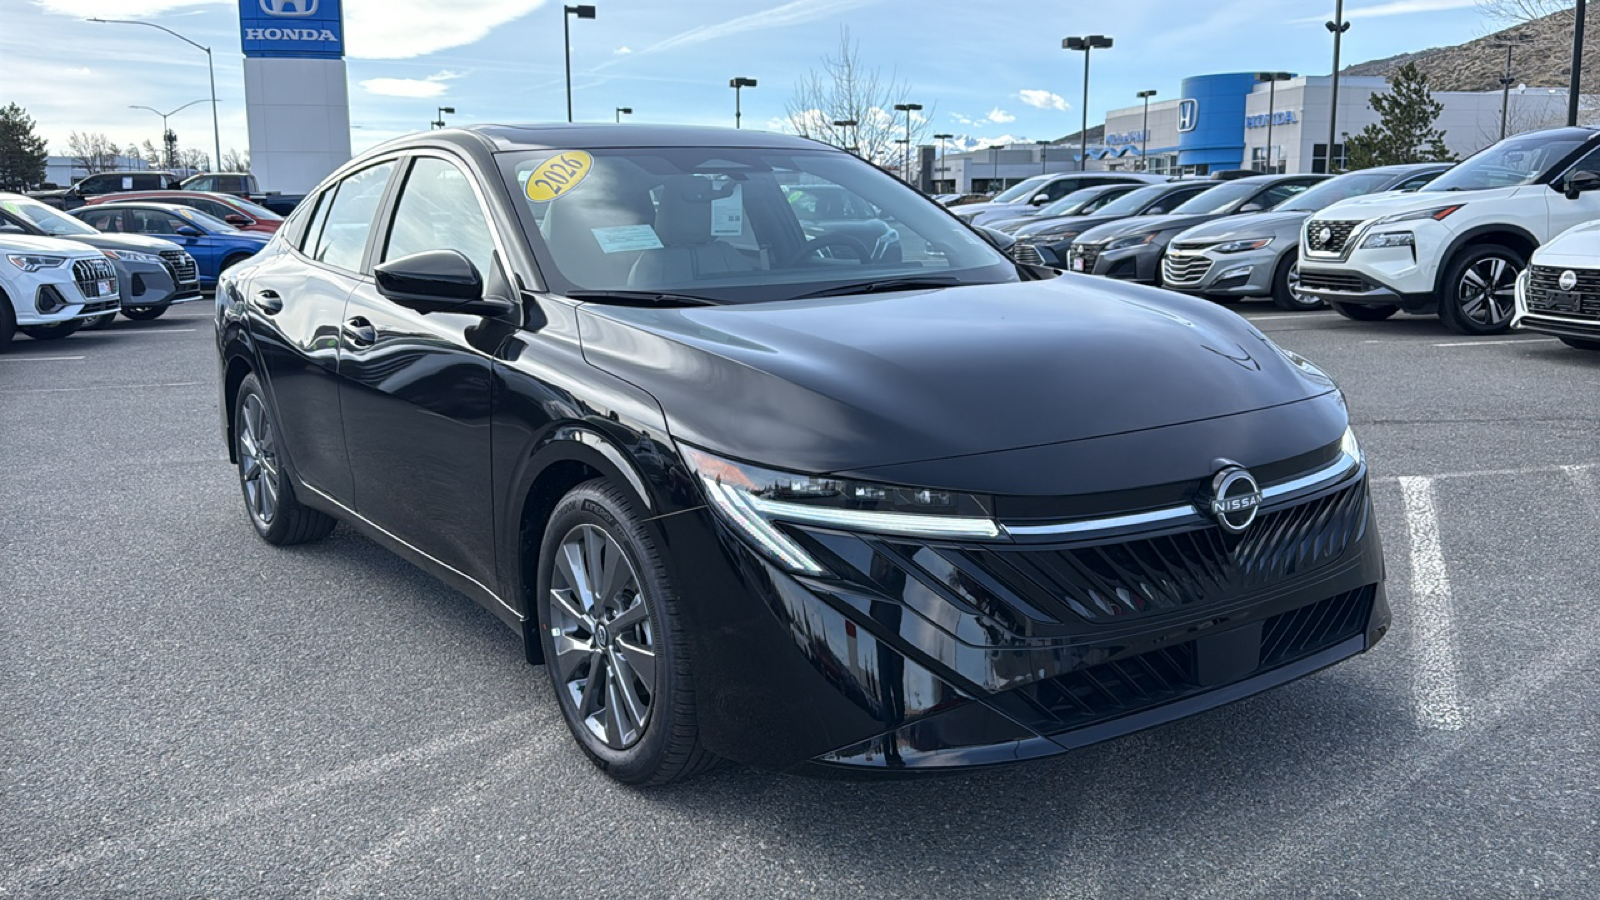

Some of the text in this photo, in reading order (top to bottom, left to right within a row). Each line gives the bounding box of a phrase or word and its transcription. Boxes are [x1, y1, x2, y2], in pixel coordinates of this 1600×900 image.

[245, 28, 338, 41] HONDA
[1246, 111, 1297, 128] HONDA
[534, 154, 583, 195] 2026
[1214, 494, 1262, 512] NISSAN
